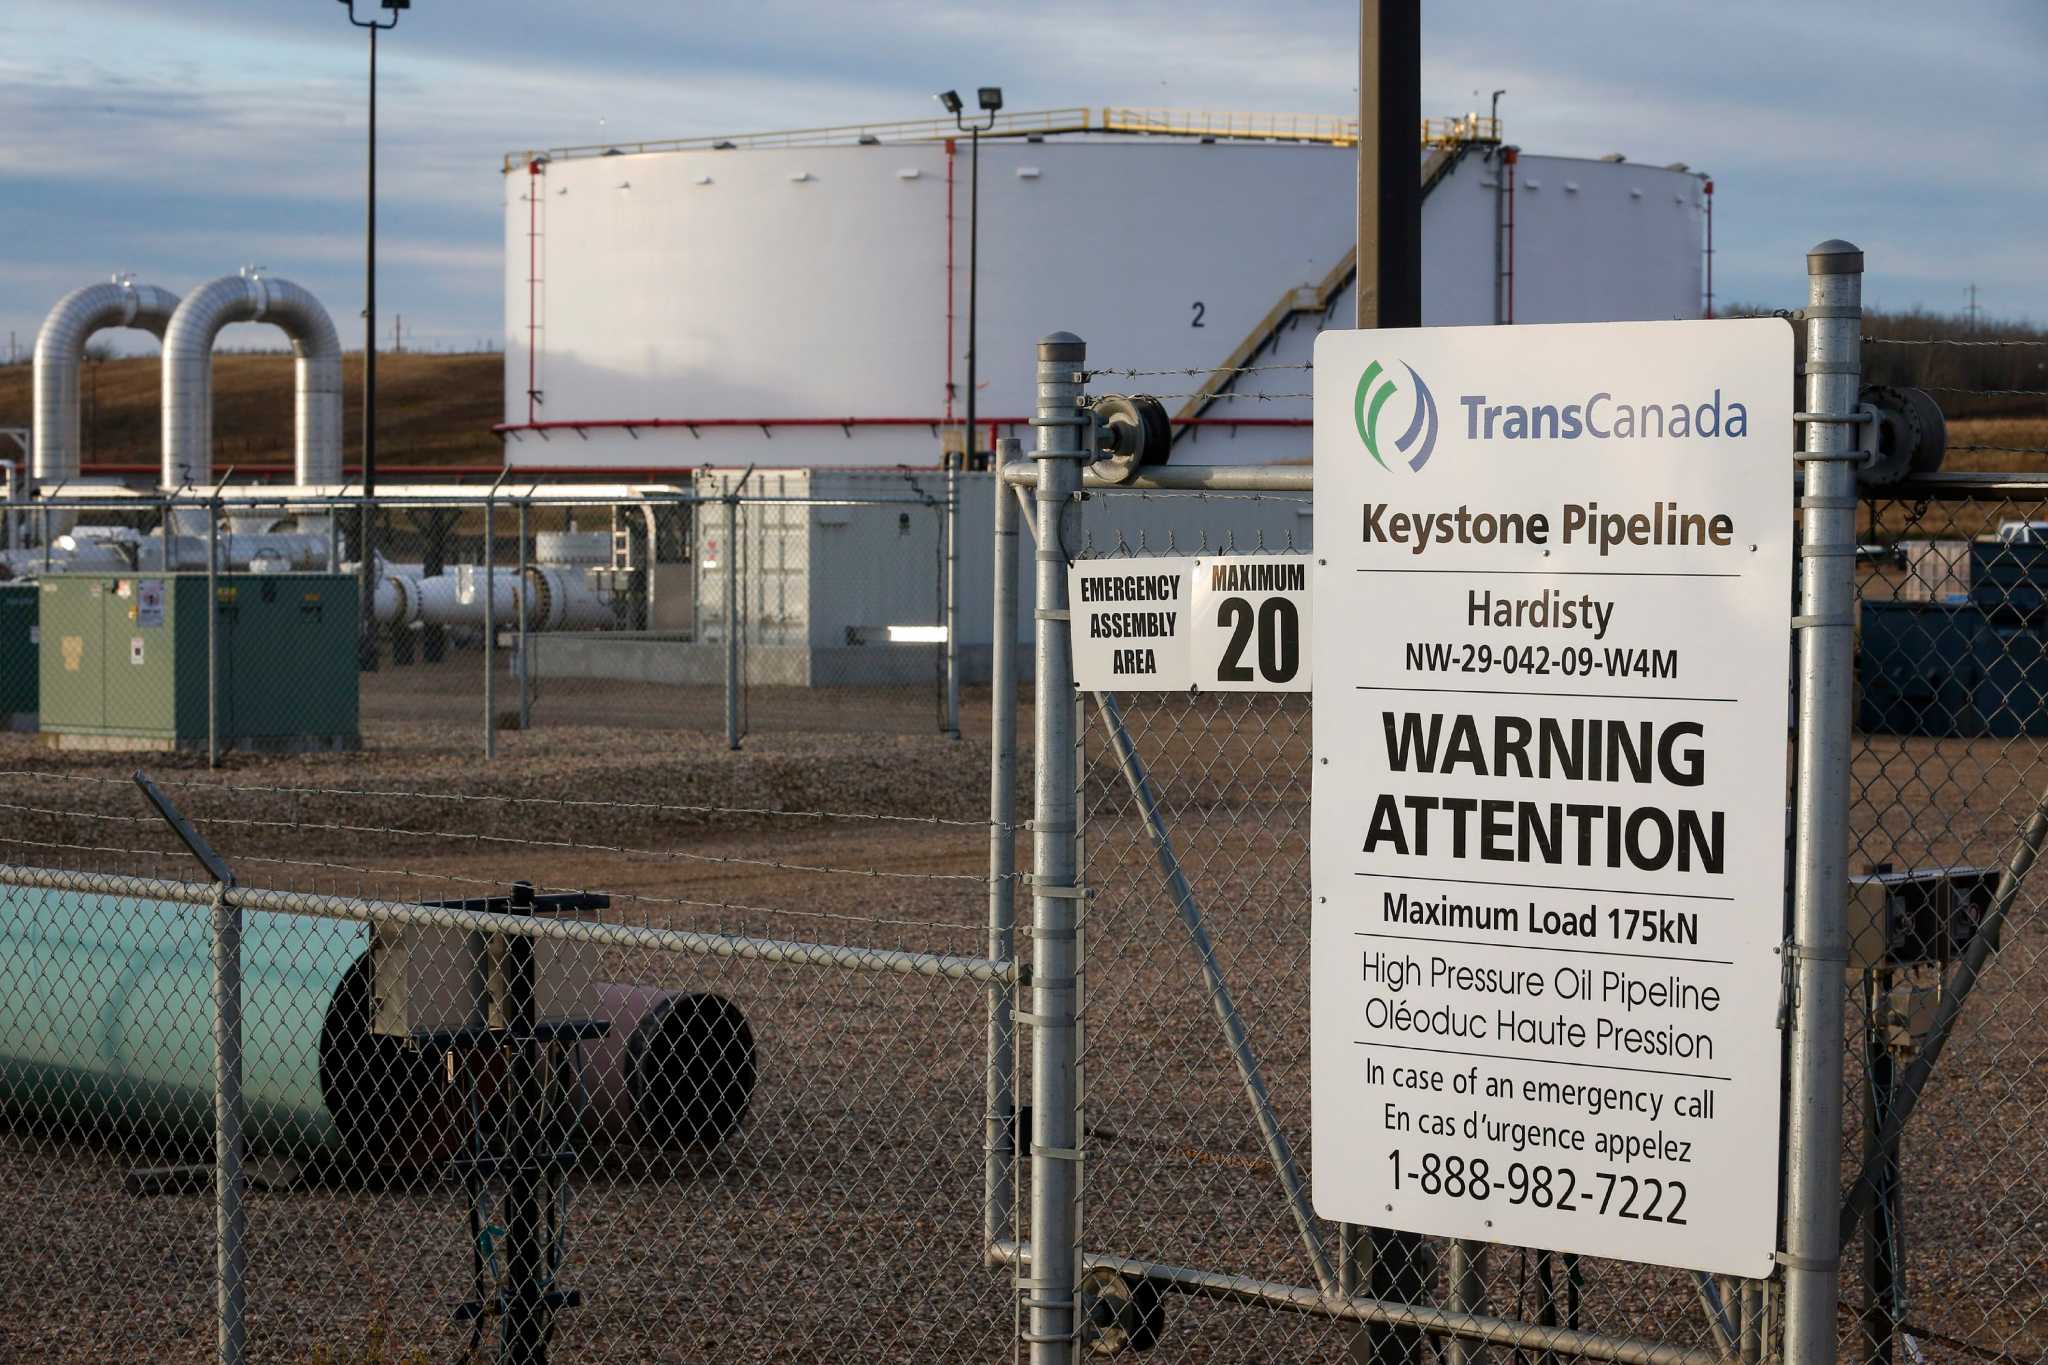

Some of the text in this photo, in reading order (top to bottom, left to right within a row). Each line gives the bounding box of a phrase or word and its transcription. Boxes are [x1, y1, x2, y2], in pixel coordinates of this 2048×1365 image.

[1192, 302, 1205, 328] 2
[1460, 388, 1748, 440] TransCanada
[1362, 501, 1734, 557] Keystone Pipeline
[1080, 574, 1181, 603] EMERGENCY
[1211, 563, 1305, 592] MAXIMUM
[1090, 611, 1177, 639] ASSEMBLY
[1217, 596, 1300, 684] 20
[1467, 588, 1615, 641] Hardisty
[1113, 648, 1157, 675] AREA
[1405, 642, 1678, 679] NW-29-042-09-W4M
[1381, 711, 1705, 787] WARNING
[1362, 793, 1725, 875] ATTENTION
[1382, 891, 1698, 945] Maximum Load 175kN
[1363, 951, 1721, 1013] High Pressure Oil Pipeline
[1365, 997, 1713, 1060] Oléoduc Haute Pression
[1367, 1057, 1714, 1122] In case of an emergency call
[1385, 1102, 1410, 1132] En
[1418, 1114, 1456, 1138] cas
[1594, 1129, 1692, 1164] appelez
[1388, 1149, 1688, 1226] 1-888-982-7222
